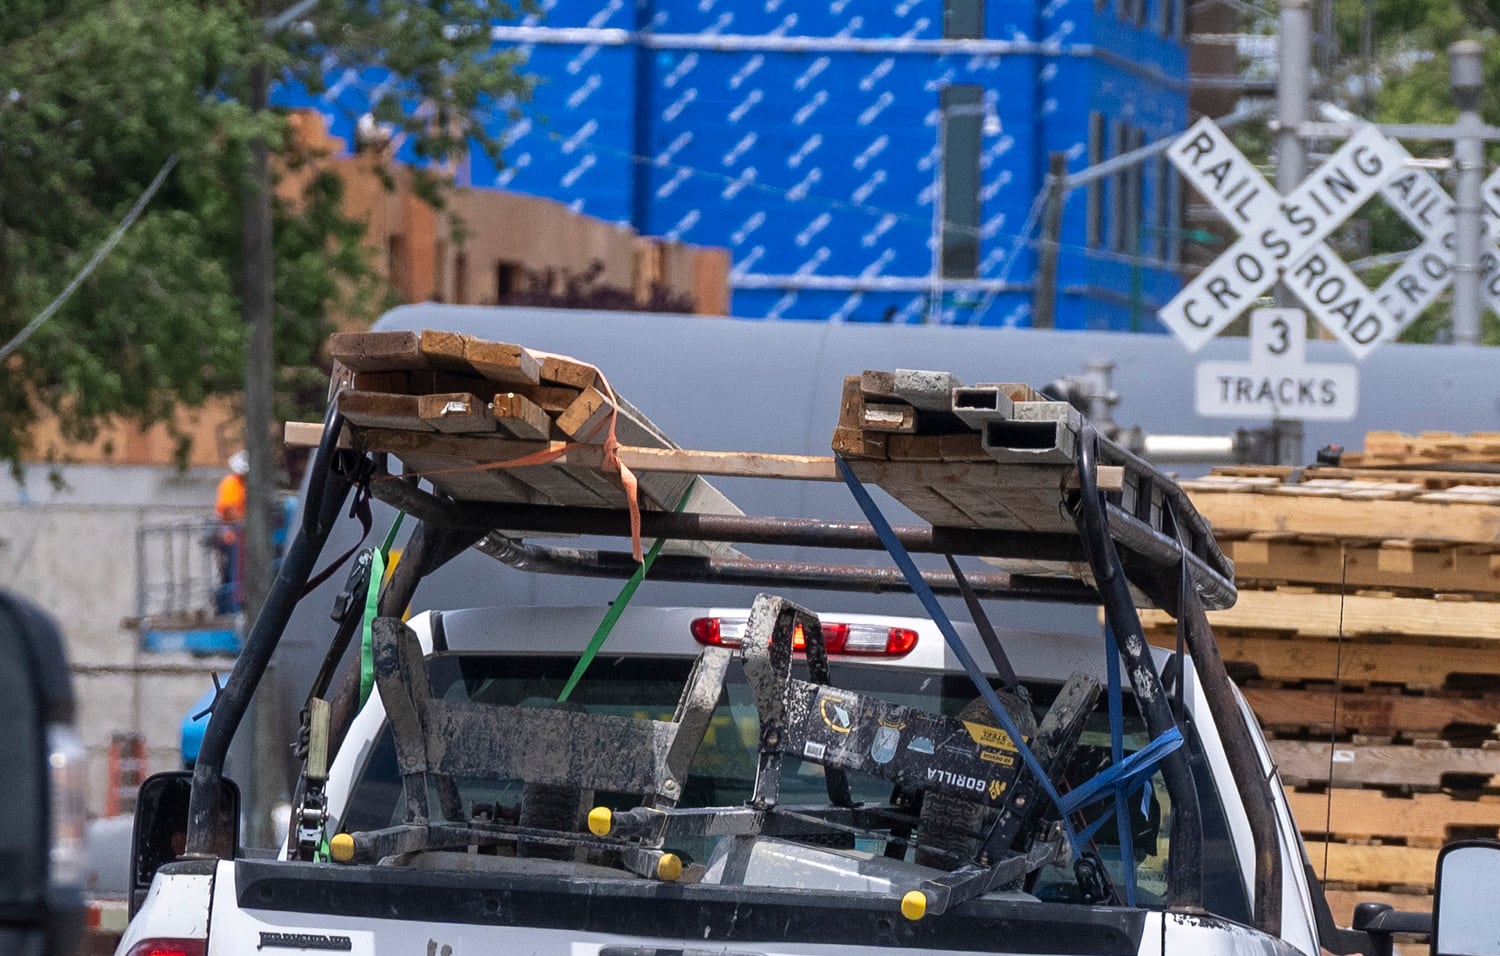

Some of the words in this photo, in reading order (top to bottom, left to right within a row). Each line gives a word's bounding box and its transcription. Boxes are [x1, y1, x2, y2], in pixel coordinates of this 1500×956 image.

[1388, 173, 1440, 227] AIL
[1181, 130, 1254, 223] RAIL
[1294, 255, 1382, 346] ROAD
[1183, 145, 1383, 330] CROSSING
[1267, 318, 1291, 355] 3
[1217, 376, 1336, 405] TRACKS
[927, 767, 986, 792] GORILLA
